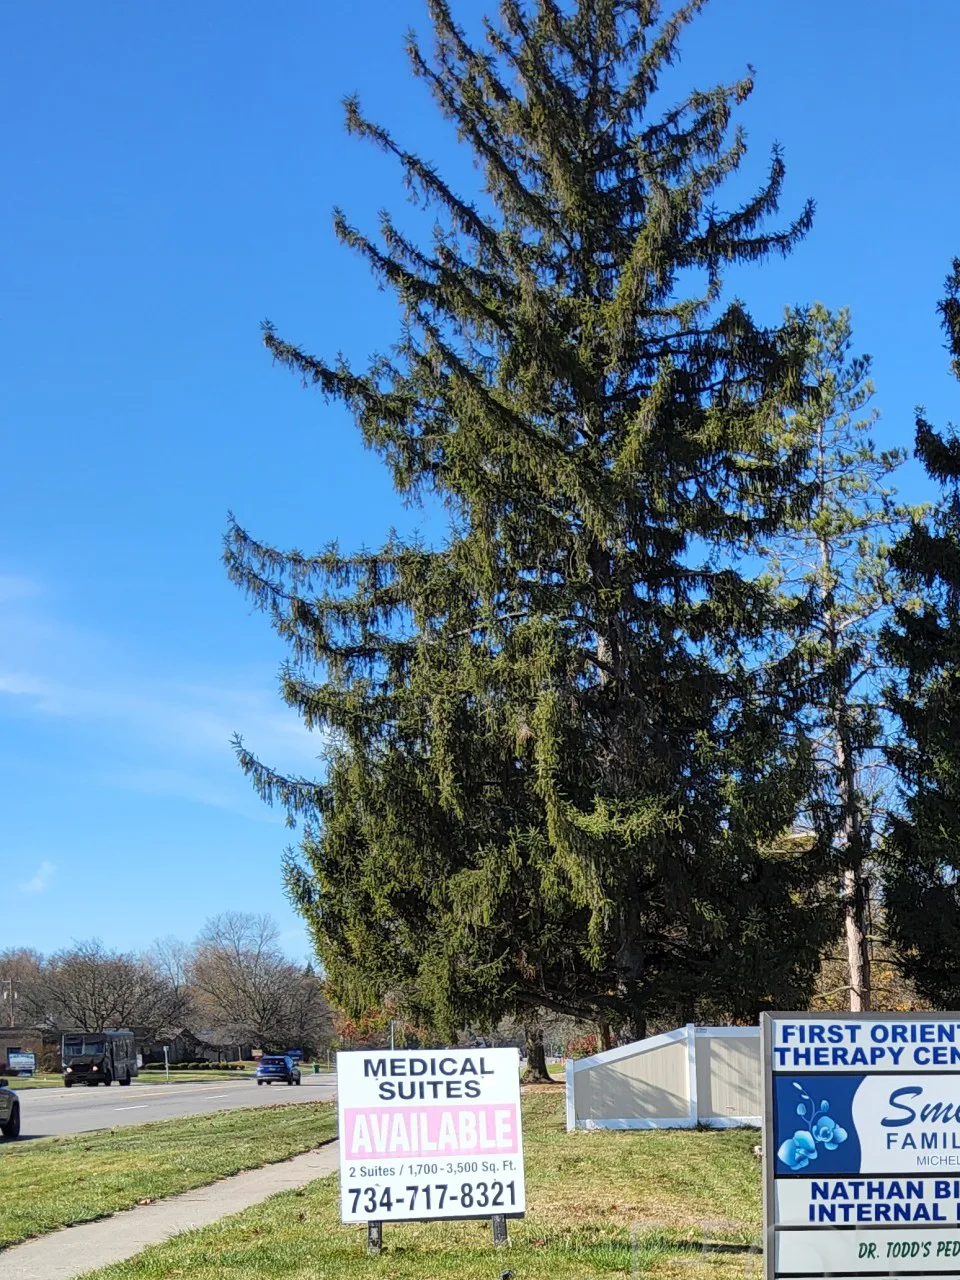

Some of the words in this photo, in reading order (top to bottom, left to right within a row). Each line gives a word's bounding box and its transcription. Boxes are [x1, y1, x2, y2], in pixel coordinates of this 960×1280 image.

[781, 1024, 862, 1044] FIRST
[774, 1045, 903, 1066] THERAPY
[363, 1057, 495, 1078] MEDICAL
[378, 1080, 482, 1101] SUITES
[351, 1109, 513, 1154] AVAILABLE
[349, 1166, 357, 1178] 2
[360, 1165, 396, 1177] Suites
[481, 1160, 499, 1174] Sq.
[502, 1159, 517, 1172] Ft.
[347, 1180, 517, 1214] 734-717-8321
[811, 1181, 924, 1201] NATHAN
[808, 1202, 948, 1223] INTERNAL
[858, 1241, 881, 1260] DR.
[886, 1240, 933, 1259] TODD'S
